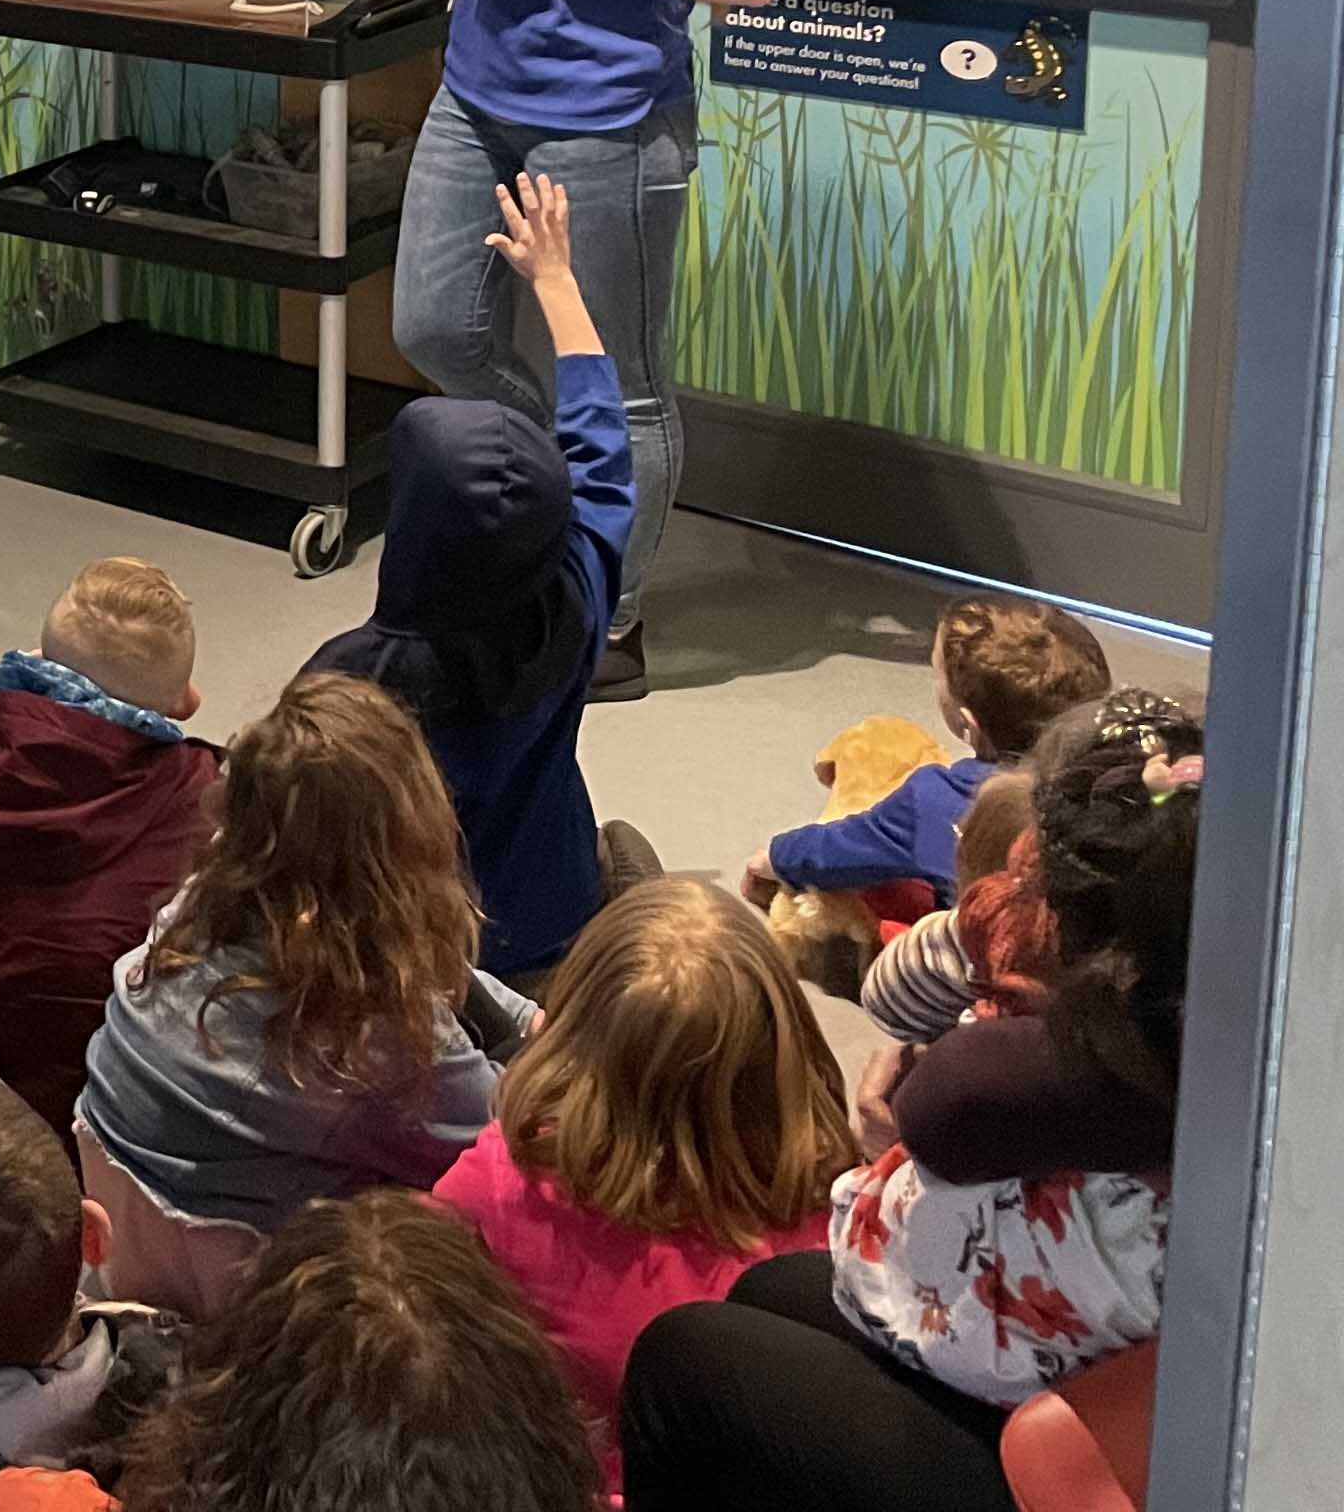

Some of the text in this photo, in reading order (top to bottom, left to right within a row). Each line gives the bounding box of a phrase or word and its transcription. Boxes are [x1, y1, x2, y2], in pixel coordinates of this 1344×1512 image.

[725, 8, 887, 43] about animals?
[723, 53, 920, 90] here to answer your questions!
[724, 34, 927, 73] If the upper door is open, we're
